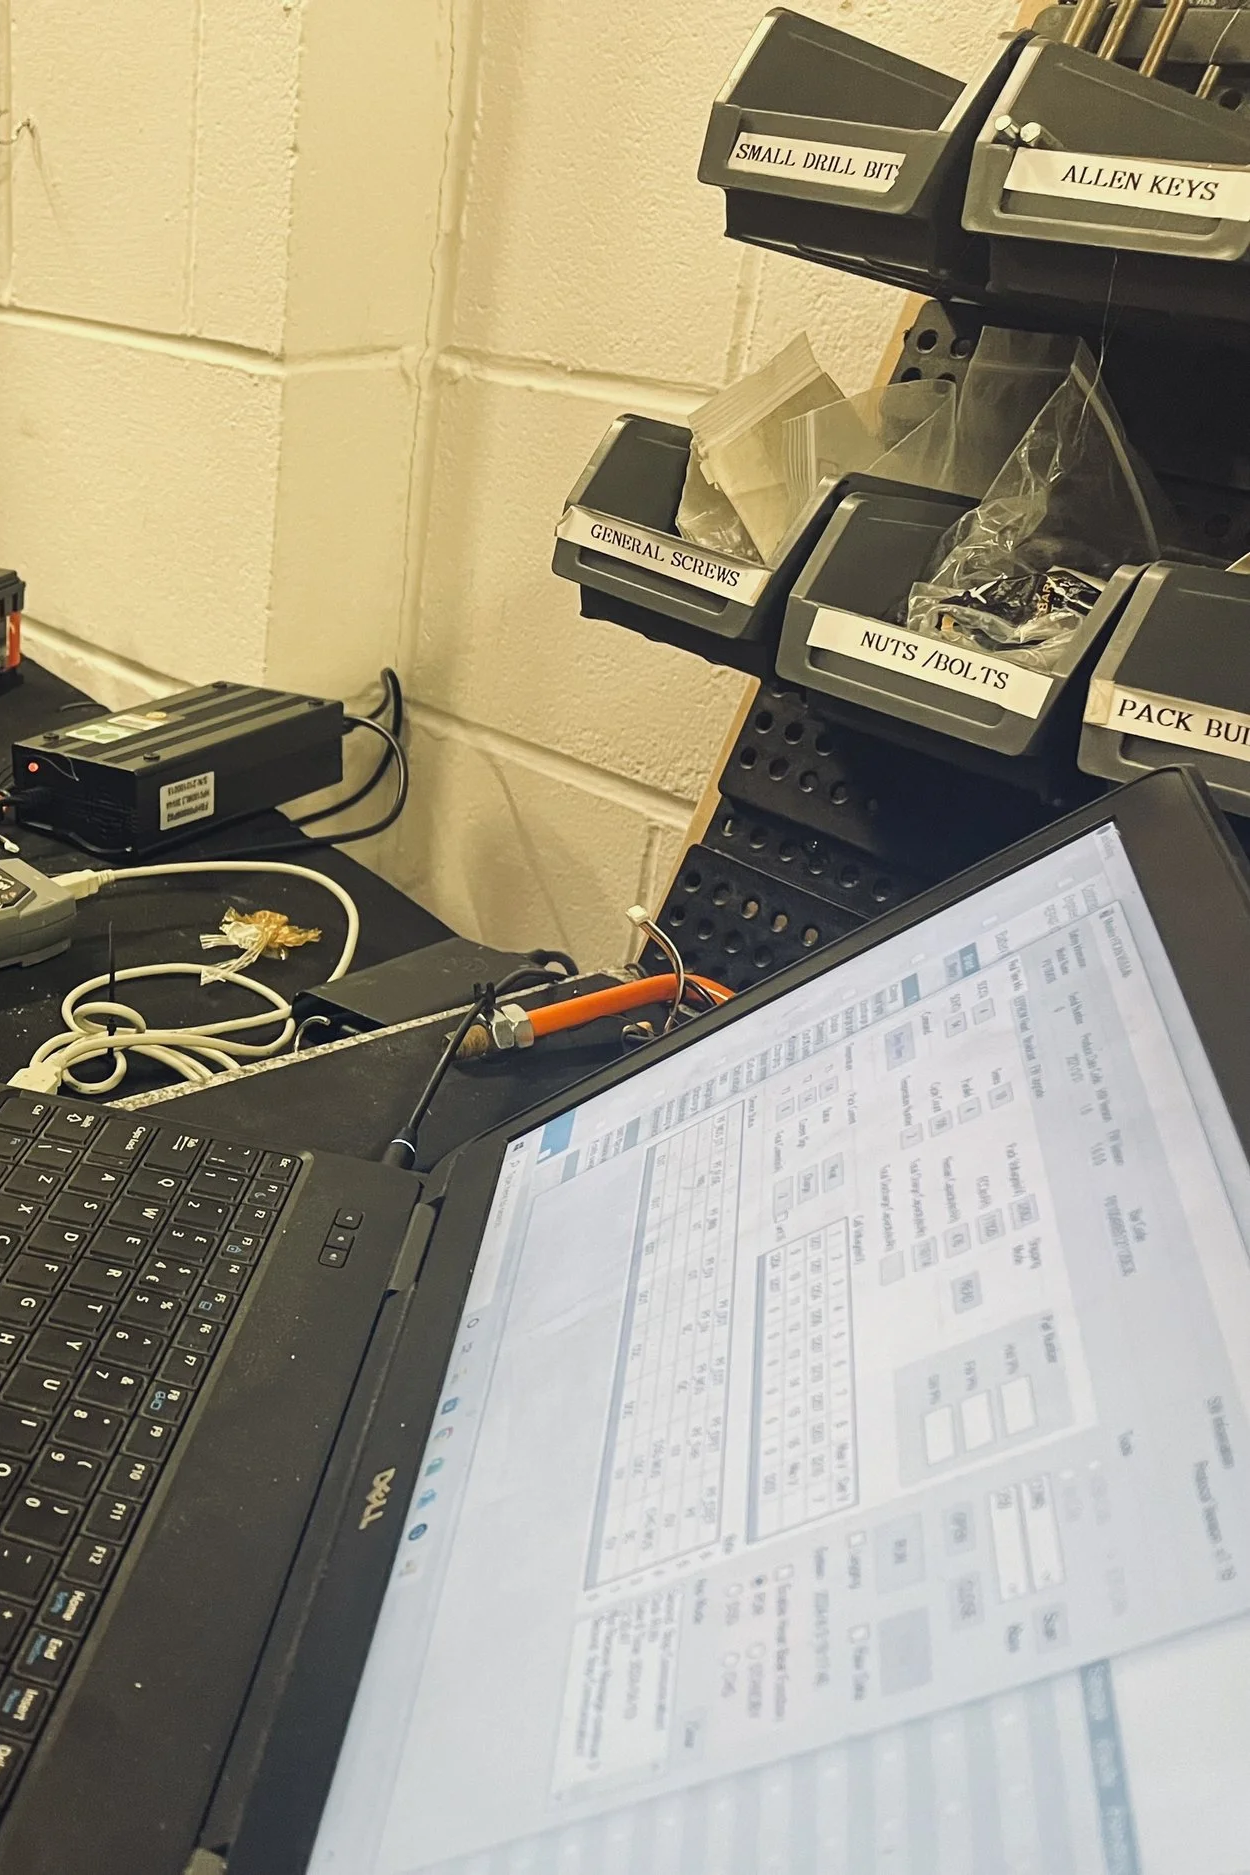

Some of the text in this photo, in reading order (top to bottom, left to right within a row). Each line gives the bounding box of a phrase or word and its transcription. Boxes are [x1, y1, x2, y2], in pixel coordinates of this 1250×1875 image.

[735, 143, 899, 181] SMALL DRILL BIT
[1061, 164, 1220, 202] ALLEN KEYS
[590, 523, 741, 587] GENERAL SCREWS
[860, 630, 1010, 690] NUTS /BOLTS
[1117, 698, 1195, 732] PACK
[31, 1104, 44, 1115] Ctrl
[80, 1114, 95, 1128] Shift
[10, 1137, 21, 1145] Fn
[125, 1126, 146, 1151] Caps Lock
[186, 1138, 199, 1148] Tab
[279, 1158, 292, 1168] Esc
[37, 1174, 54, 1184] Z
[101, 1173, 116, 1181] A
[157, 1178, 175, 1187] Q
[267, 1184, 278, 1193] F1
[17, 1203, 34, 1214] X
[83, 1201, 98, 1210] S
[142, 1208, 159, 1220] W
[254, 1210, 266, 1219] F2
[64, 1232, 79, 1242] D
[172, 1230, 185, 1238] 3
[125, 1236, 141, 1245] E
[241, 1237, 253, 1246] F3
[44, 1263, 59, 1273] F
[155, 1261, 167, 1269] 4
[229, 1264, 240, 1274] F4
[106, 1268, 123, 1278] R
[20, 1297, 36, 1308] G
[136, 1295, 149, 1303] 5
[214, 1293, 227, 1303] F5
[87, 1304, 103, 1313] T
[199, 1323, 212, 1334] F6
[116, 1331, 129, 1340] 6
[66, 1341, 83, 1351] Y
[184, 1355, 197, 1366] F7
[95, 1370, 109, 1379] 7
[43, 1379, 61, 1391] U
[167, 1389, 181, 1401] F8
[73, 1409, 88, 1419] 8
[21, 1419, 37, 1427] I
[150, 1425, 164, 1437] F9
[51, 1451, 65, 1462] 9
[129, 1463, 146, 1481] F10
[25, 1497, 41, 1508] 0
[358, 1467, 396, 1530] DELL
[109, 1502, 127, 1521] F11
[88, 1545, 107, 1565] F12
[62, 1590, 86, 1621] Home
[43, 1638, 63, 1660] End
[13, 1688, 39, 1721] Insert
